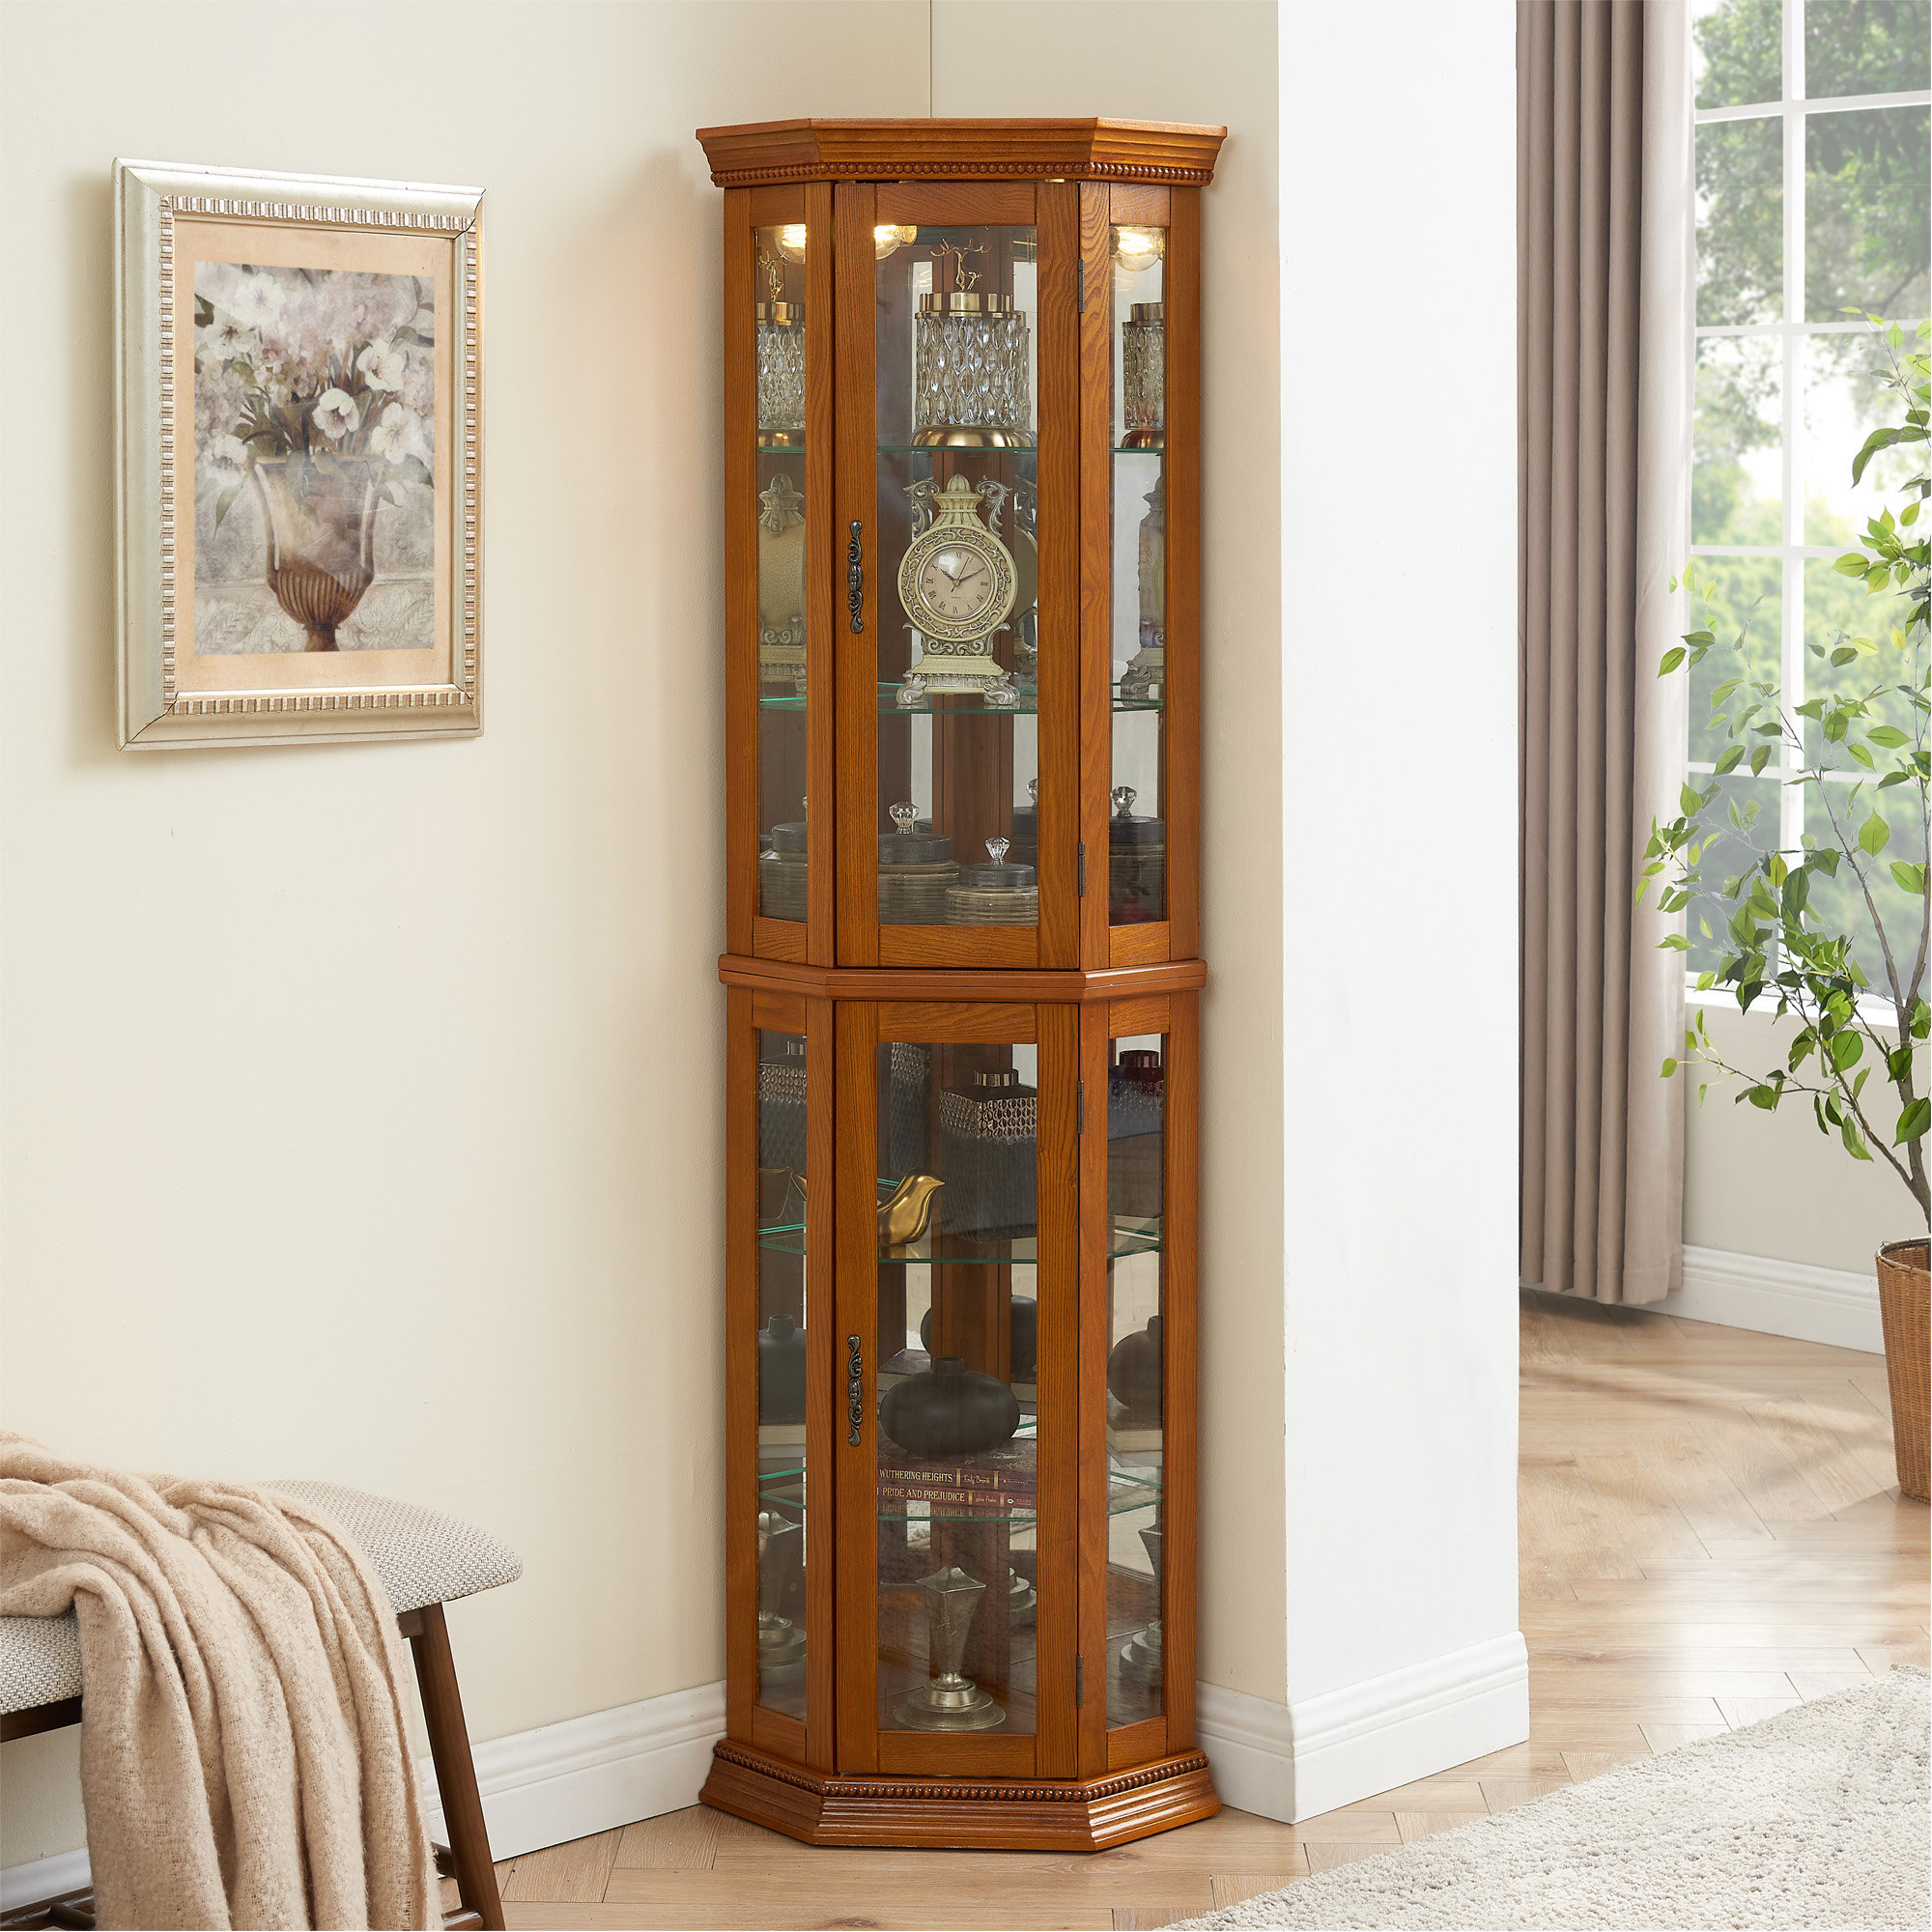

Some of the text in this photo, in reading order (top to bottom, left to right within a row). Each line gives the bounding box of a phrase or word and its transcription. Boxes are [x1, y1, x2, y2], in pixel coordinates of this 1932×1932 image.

[879, 1468, 953, 1483] WUTHERING HEIGHTS
[882, 1487, 965, 1502] PRIDE AND PREJUDICE
